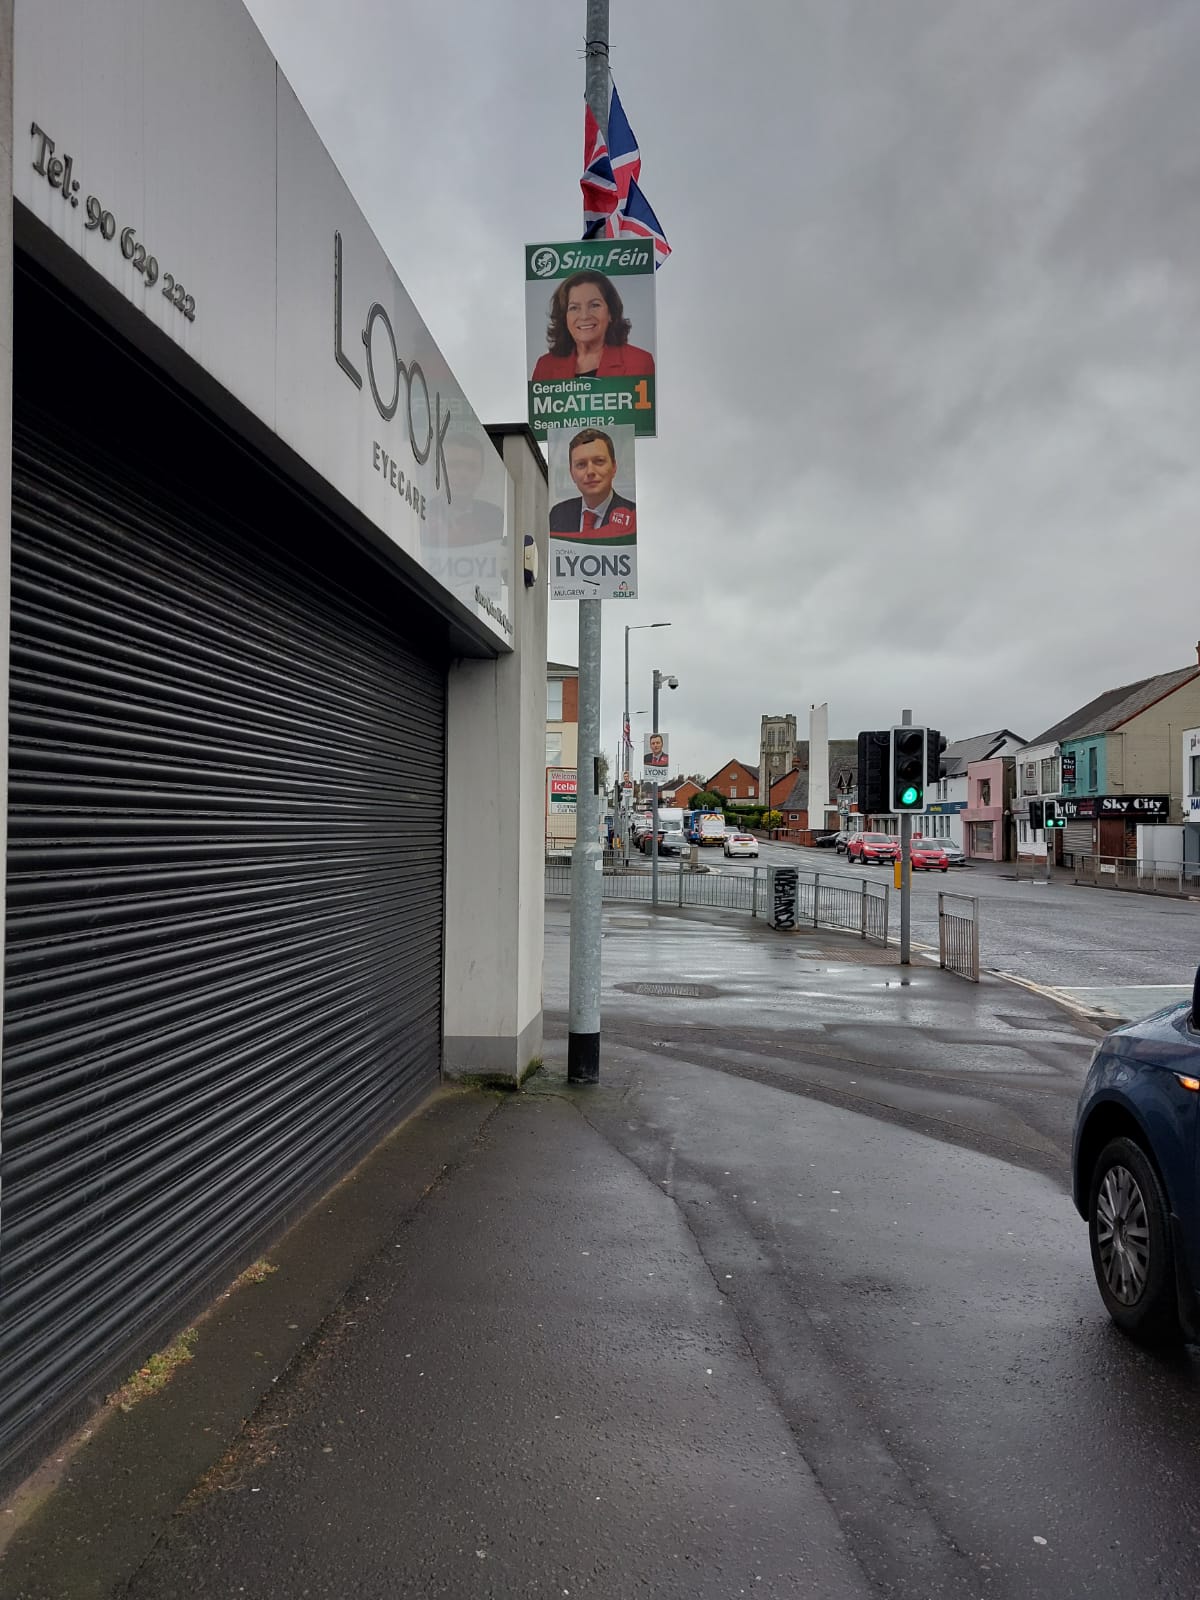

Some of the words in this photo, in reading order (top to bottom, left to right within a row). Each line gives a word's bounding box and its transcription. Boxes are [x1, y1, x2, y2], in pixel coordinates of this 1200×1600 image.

[31, 121, 80, 208] Tel:
[84, 195, 116, 241] 90
[120, 226, 158, 287] 629
[161, 272, 196, 323] 222
[560, 251, 602, 270] Sinn
[605, 247, 648, 267] Féin
[532, 381, 592, 394] Geraldine
[533, 392, 633, 414] McATEER
[635, 379, 652, 409] 1
[563, 417, 605, 428] NAPIER
[607, 416, 615, 426] 2
[372, 440, 427, 521] EYECARE
[555, 554, 631, 577] LYONS
[612, 590, 635, 598] SDLP
[644, 768, 667, 776] LYONS
[1065, 801, 1077, 817] City
[1102, 798, 1130, 812] Sky
[1133, 798, 1162, 811] City
